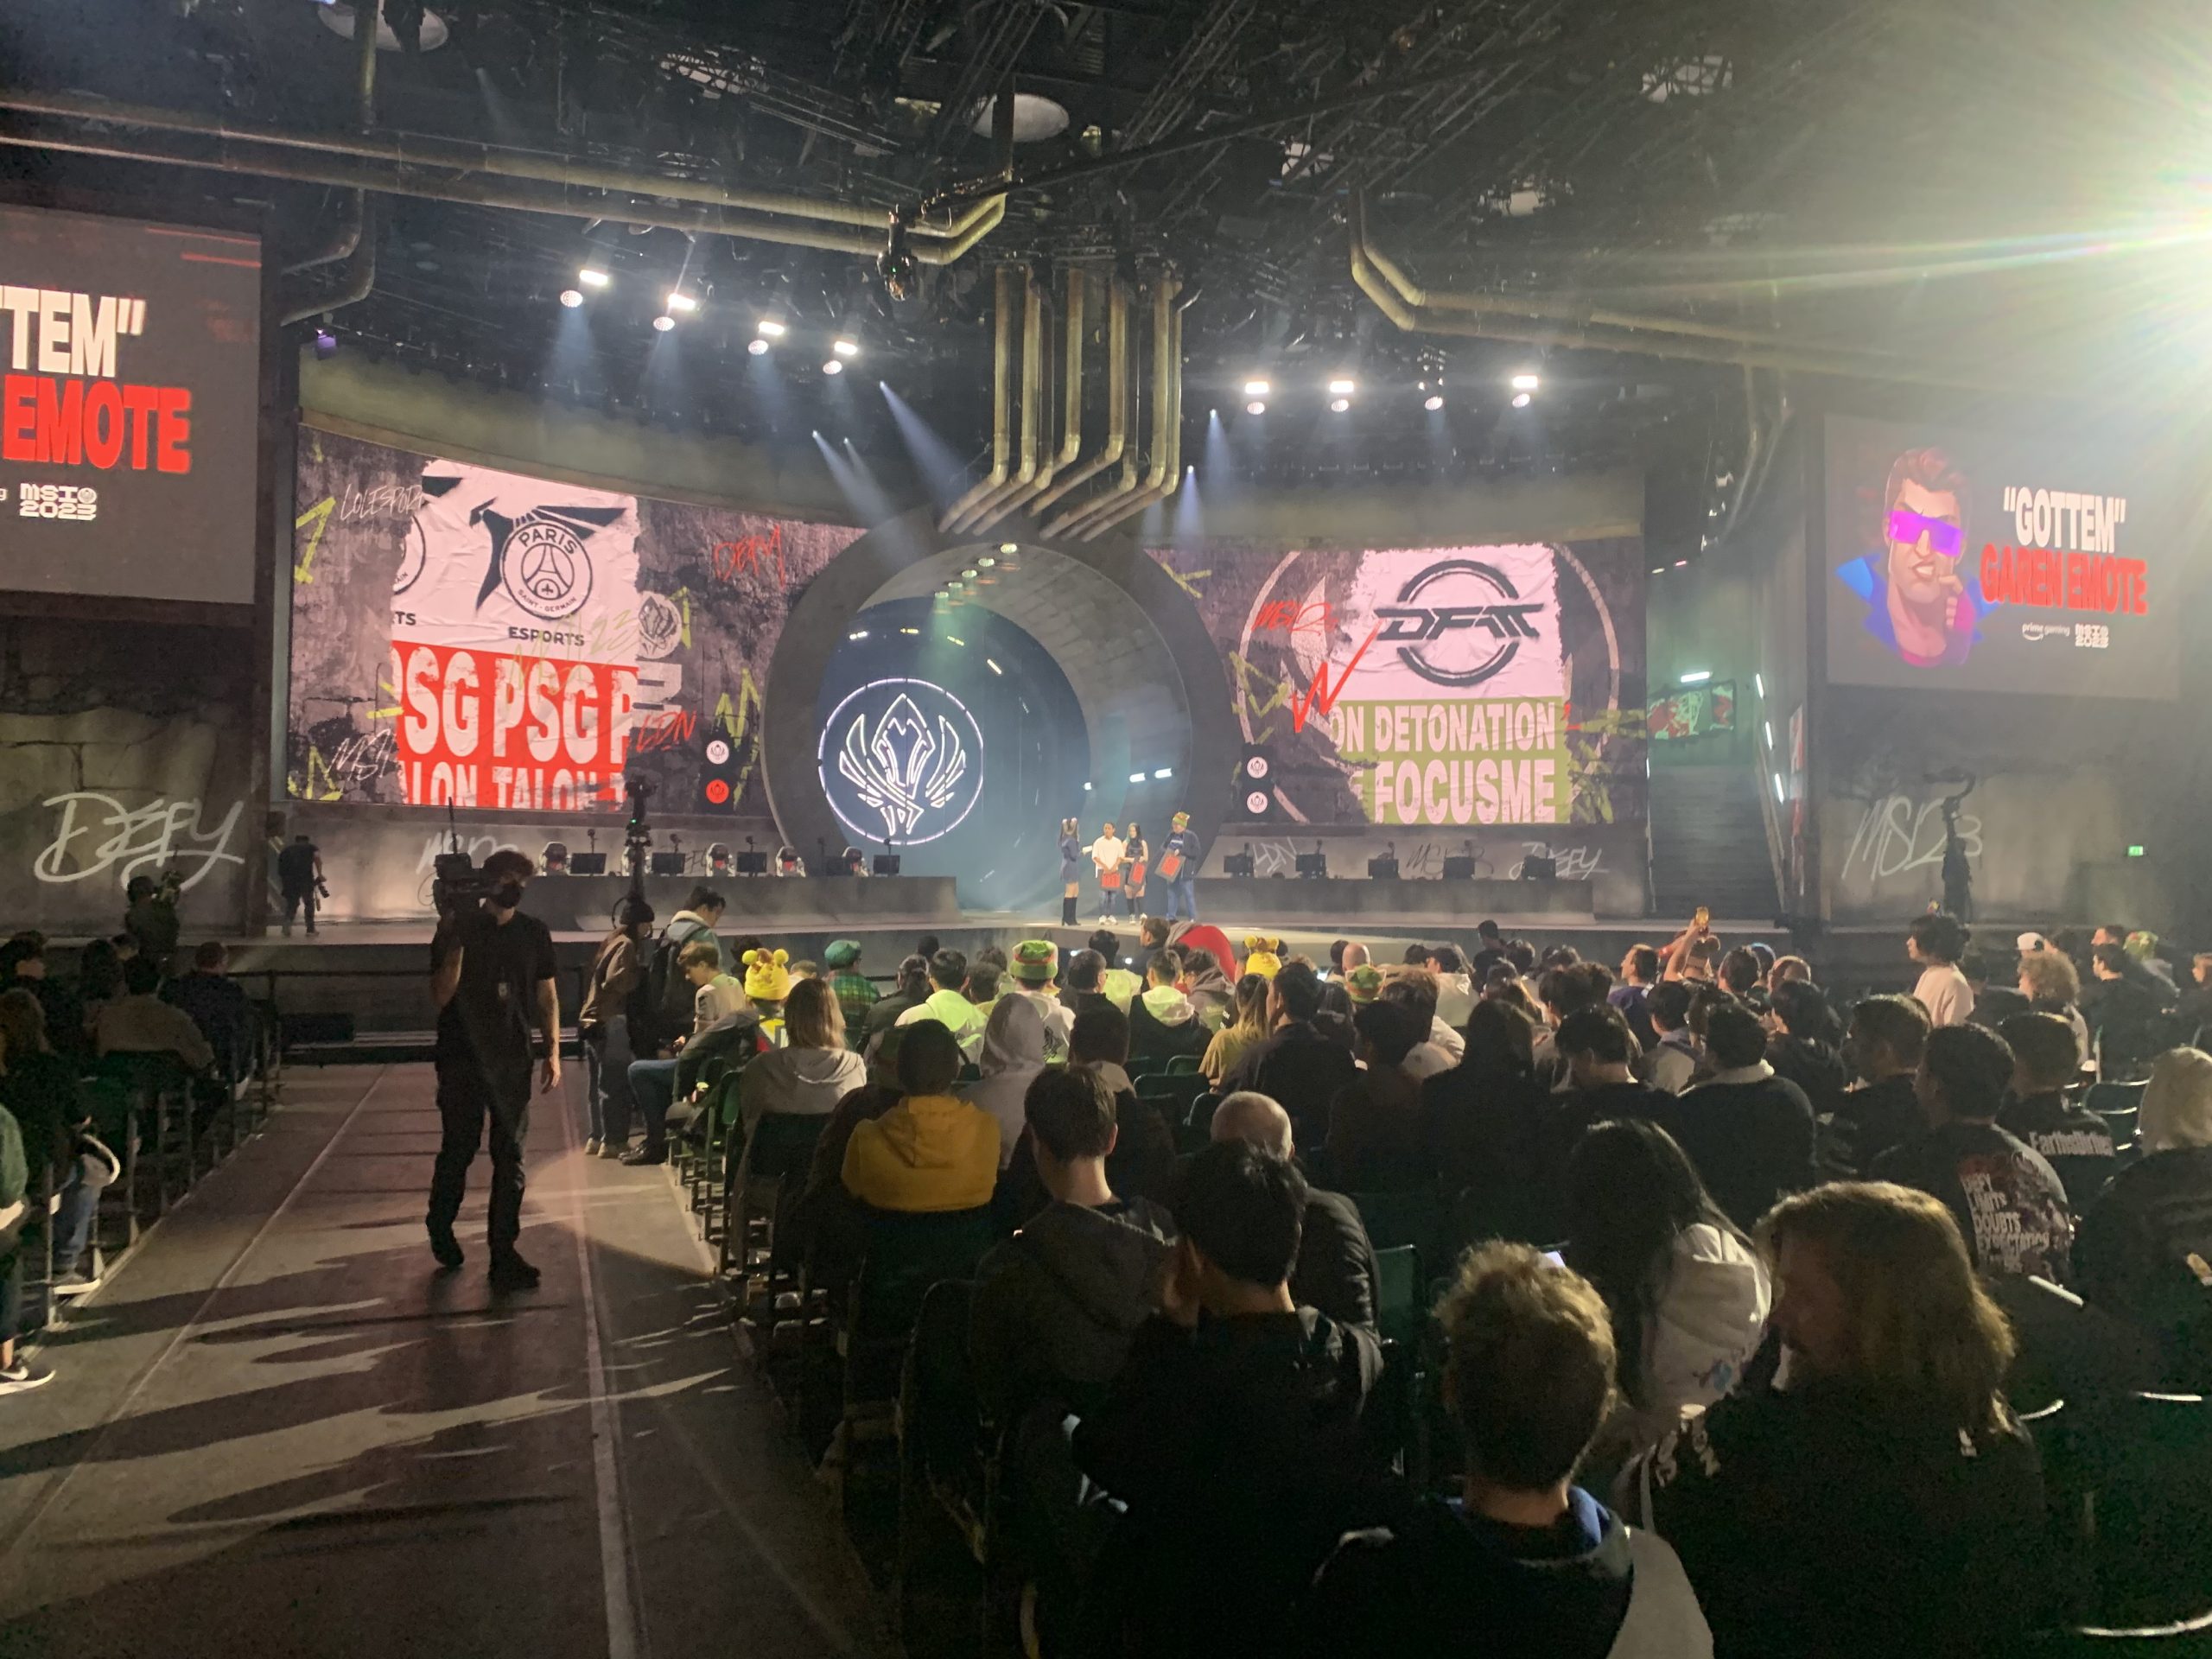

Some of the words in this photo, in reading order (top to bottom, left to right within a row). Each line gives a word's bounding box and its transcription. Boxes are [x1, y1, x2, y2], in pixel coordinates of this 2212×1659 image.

[3, 375, 192, 475] EMOTE
[19, 499, 97, 520] 2023
[2003, 486, 2126, 554] "GOTTEM"
[518, 528, 577, 555] PARIS
[518, 588, 539, 608] SAINT
[544, 596, 577, 612] GERMAIN
[1980, 543, 2063, 609] GAREN
[2067, 552, 2149, 616] EMOTE
[508, 626, 585, 646] ESPORTS
[493, 658, 598, 765] PSG
[1375, 702, 1555, 752] DETONATION
[1374, 759, 1555, 824] FOCUSME
